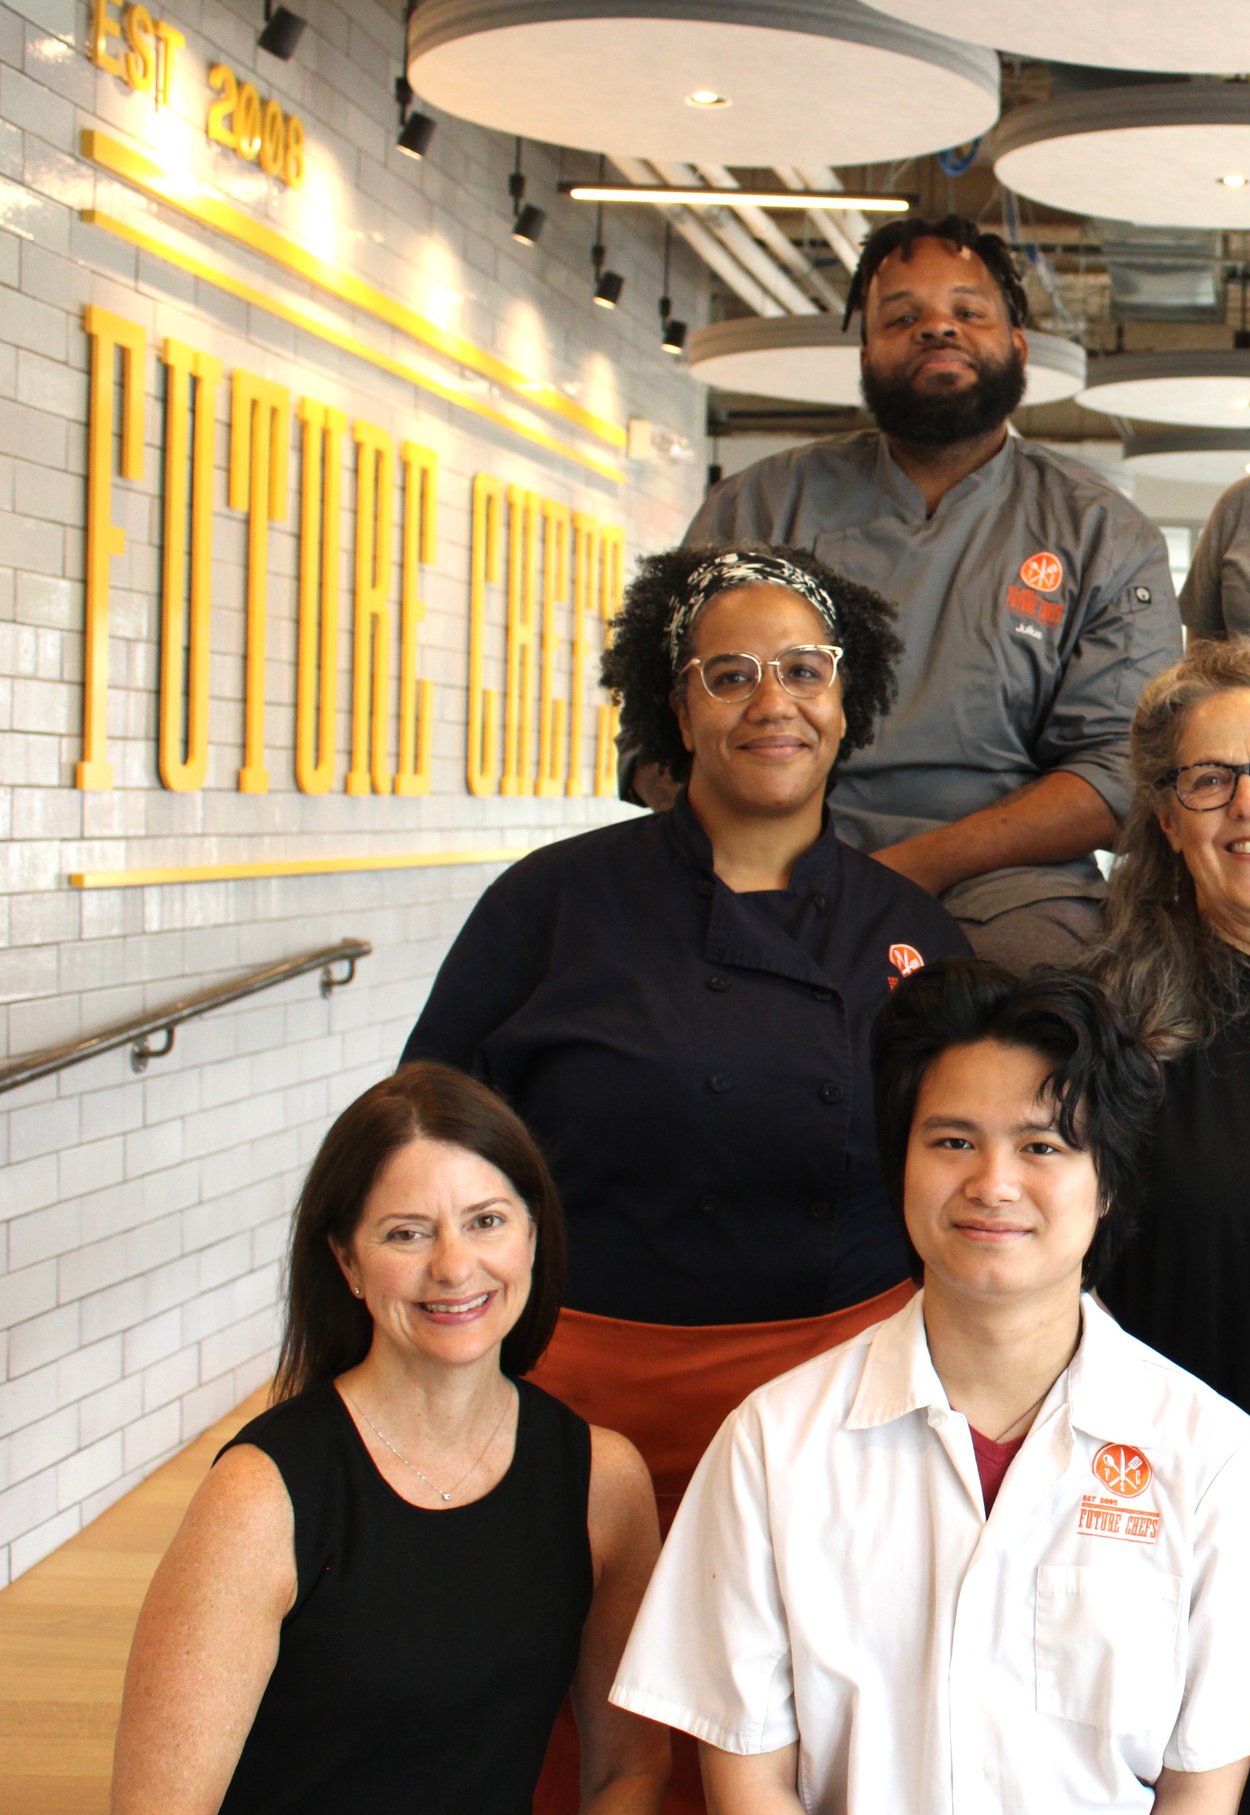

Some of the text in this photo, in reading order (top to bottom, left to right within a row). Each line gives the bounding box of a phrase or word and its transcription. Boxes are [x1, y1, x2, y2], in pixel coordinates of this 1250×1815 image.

[92, 0, 304, 190] EST 2008
[76, 304, 438, 796] FUTURE
[1078, 1508, 1159, 1538] FUTURE CHEFS
